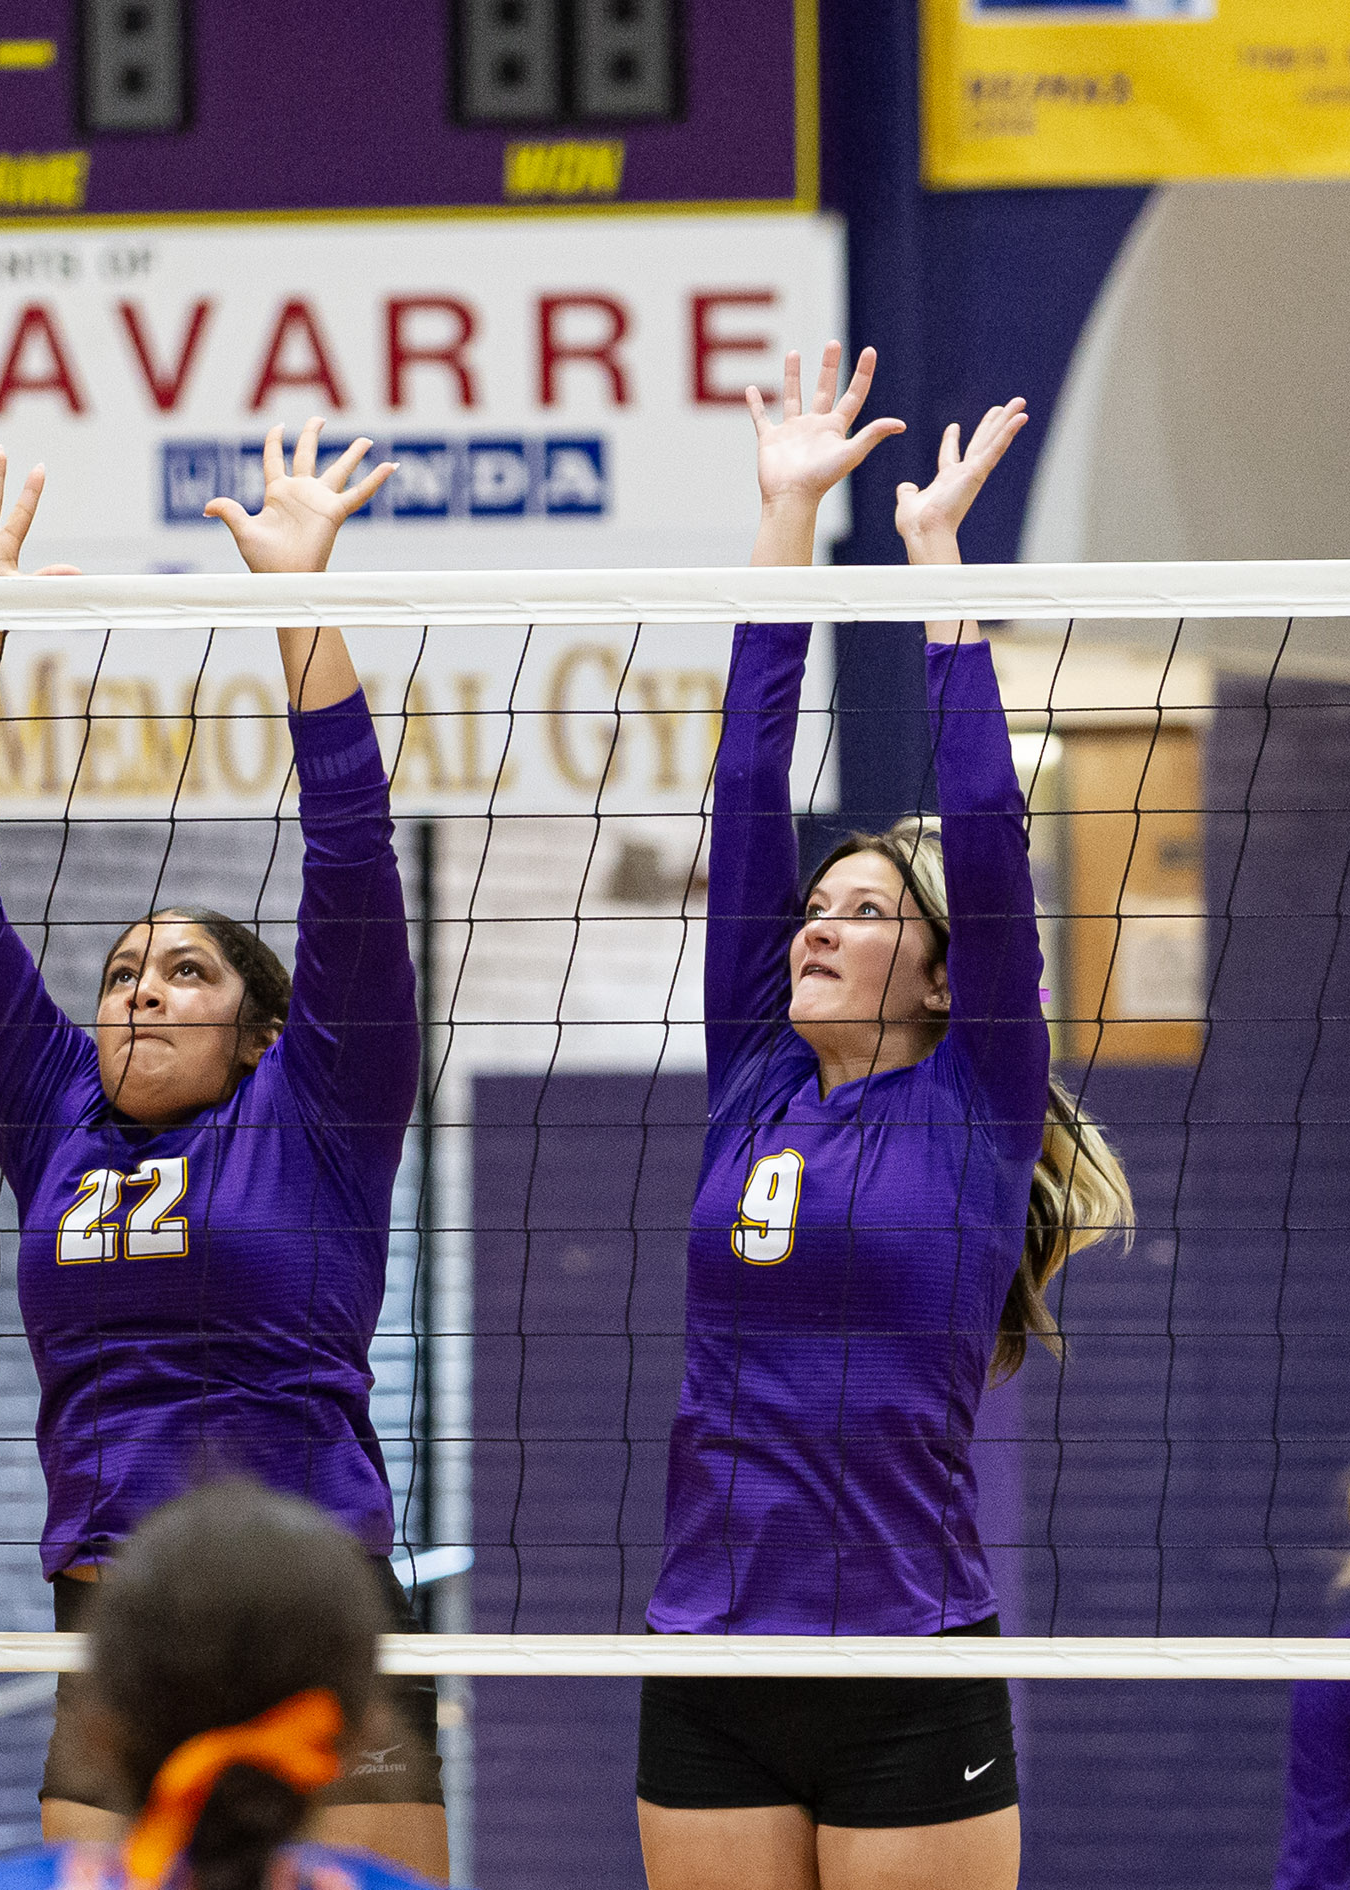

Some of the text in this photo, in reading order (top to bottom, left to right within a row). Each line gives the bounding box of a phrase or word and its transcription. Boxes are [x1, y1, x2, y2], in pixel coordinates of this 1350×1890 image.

[240, 438, 607, 517] NDA
[56, 1156, 189, 1265] 22
[731, 1148, 805, 1266] 9
